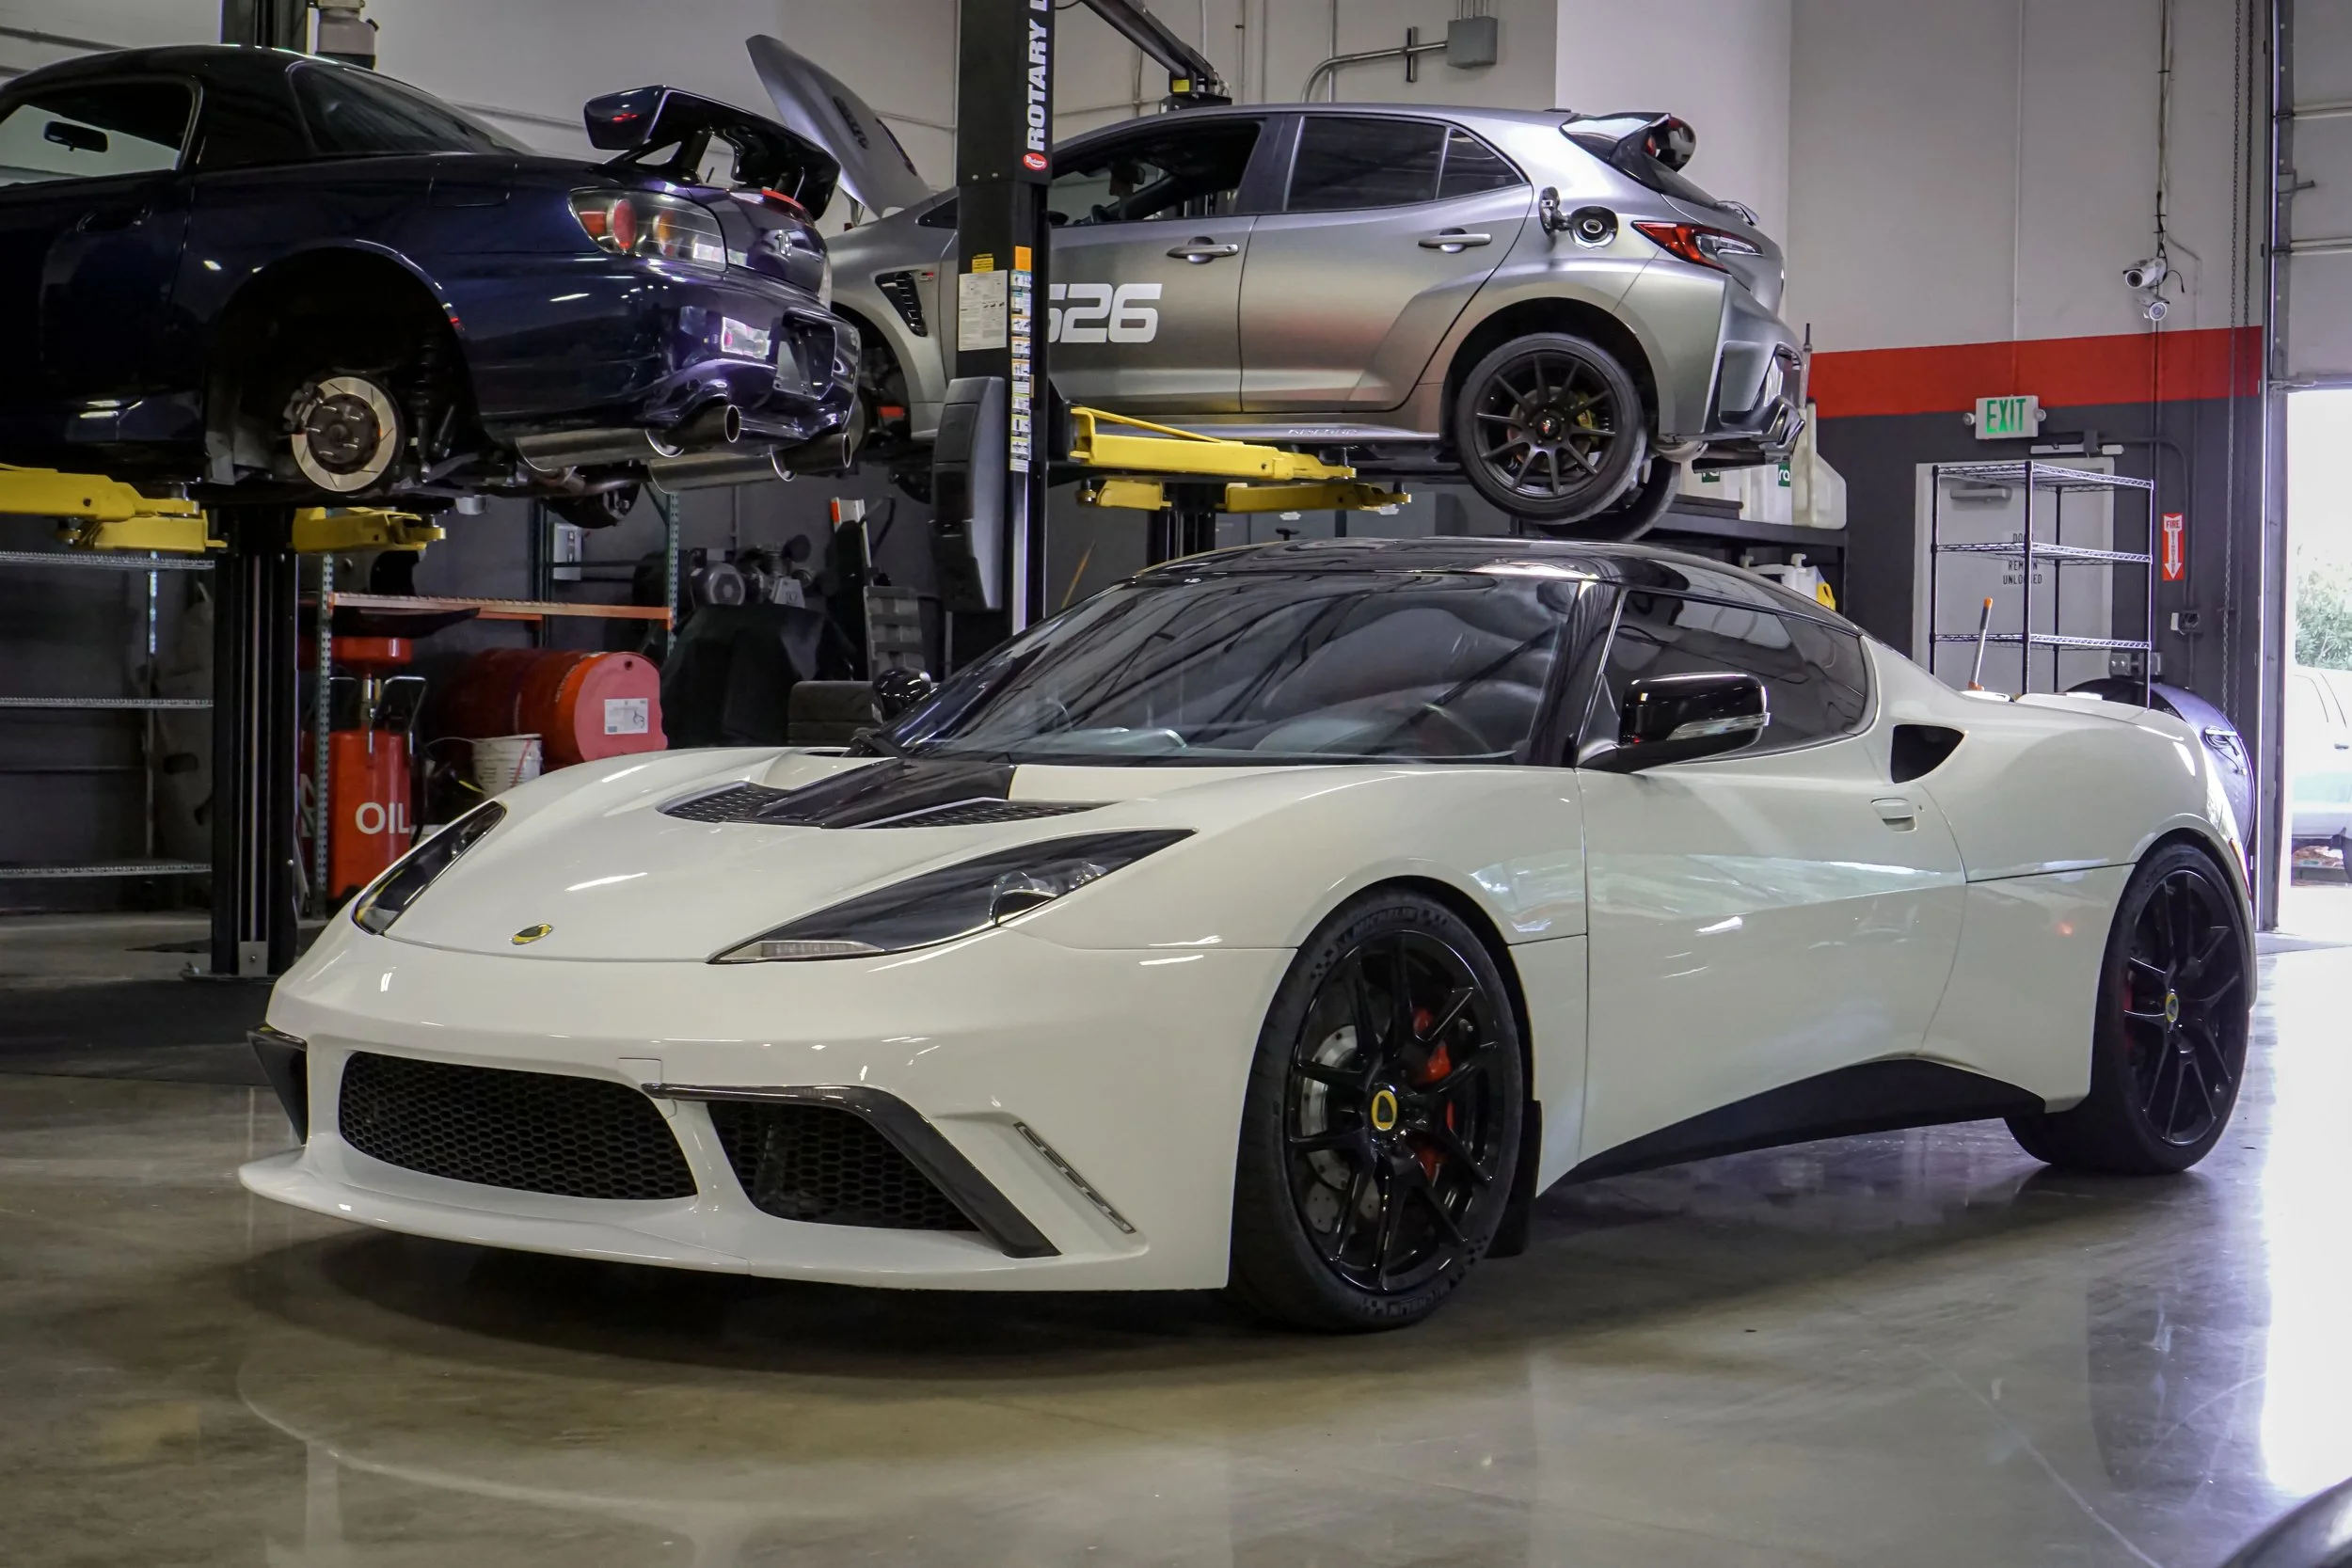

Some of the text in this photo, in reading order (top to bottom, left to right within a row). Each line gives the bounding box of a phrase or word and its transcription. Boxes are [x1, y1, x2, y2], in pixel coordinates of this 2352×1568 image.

[1027, 18, 1046, 151] ROTARY
[1986, 398, 2026, 433] EXIT
[2166, 519, 2181, 529] FIRE
[2008, 560, 2038, 571] REMN
[2002, 574, 2042, 585] UNLOED
[355, 801, 409, 835] OIL
